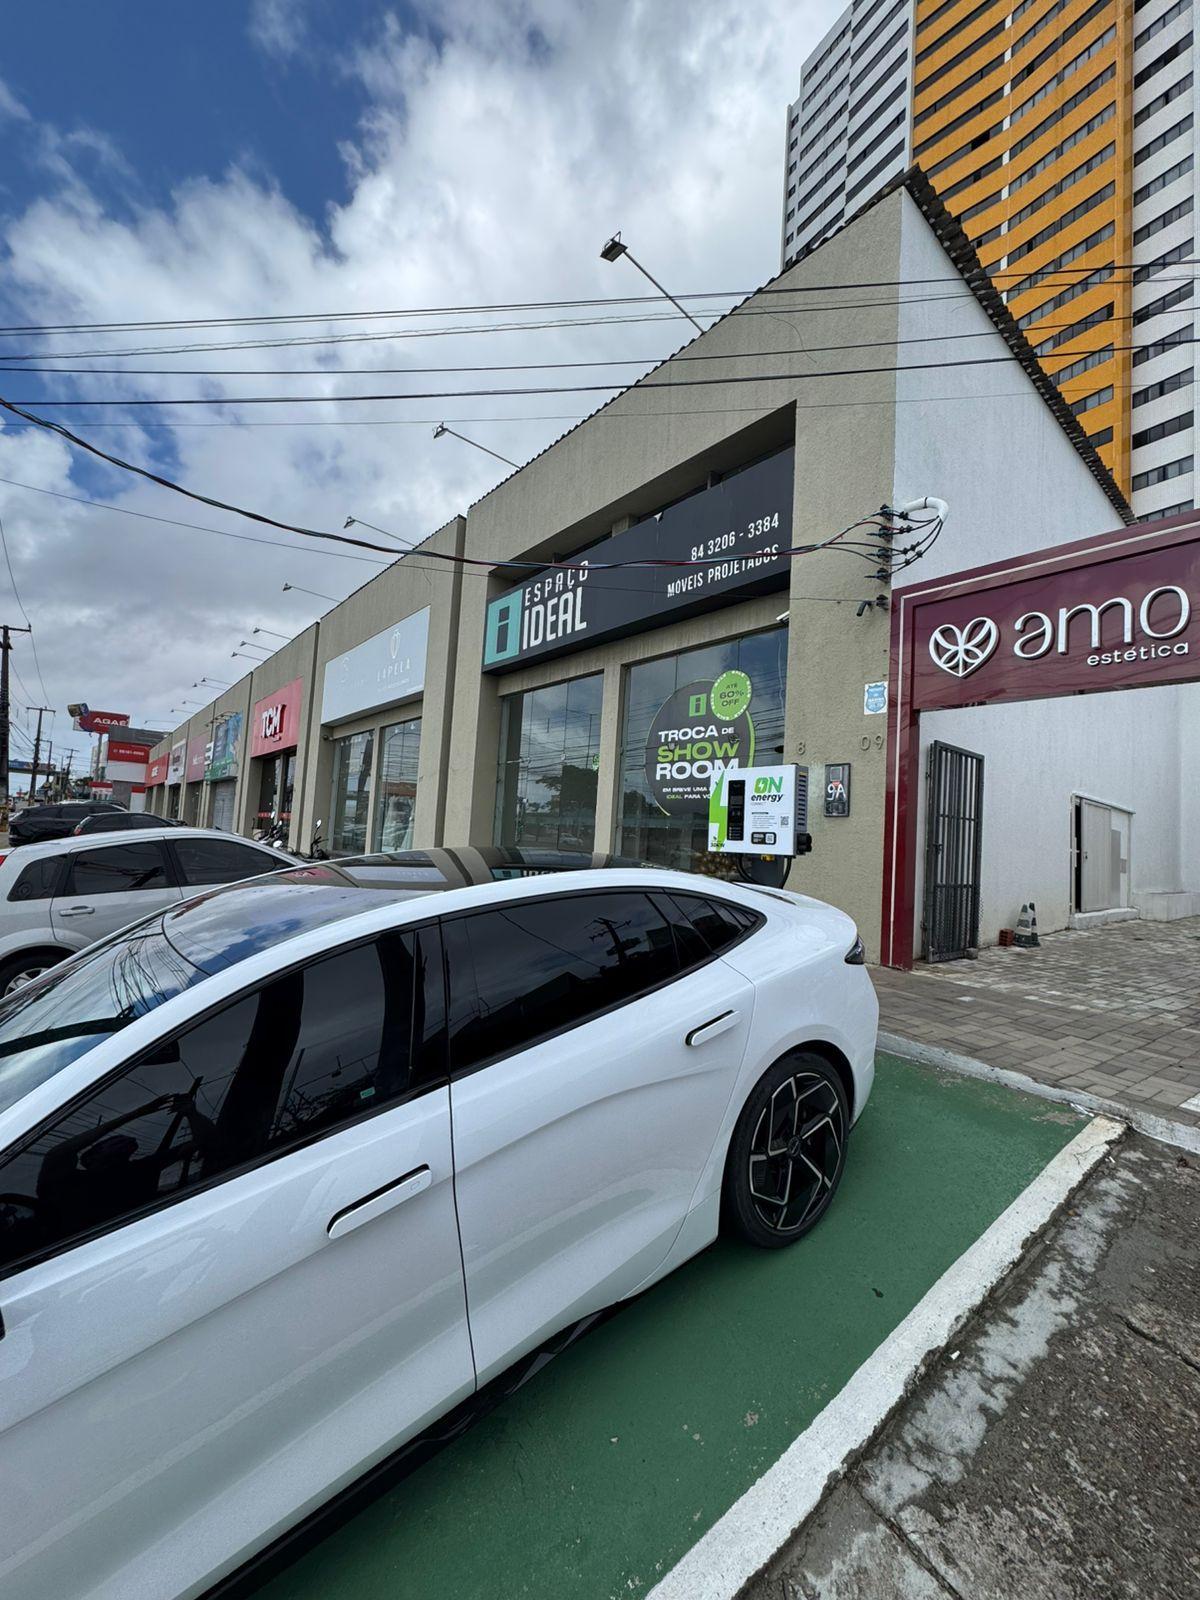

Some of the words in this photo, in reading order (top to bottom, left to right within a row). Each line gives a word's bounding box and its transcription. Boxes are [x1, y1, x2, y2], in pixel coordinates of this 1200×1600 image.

[691, 544, 704, 561] 84
[707, 531, 736, 555] 3206
[748, 512, 779, 539] 3384
[707, 544, 780, 583] PROJETADOS
[524, 560, 589, 607] ESPAÇO
[522, 587, 587, 650] IDEAL
[1013, 585, 1191, 660] amo
[1087, 641, 1190, 667] estética
[262, 704, 283, 738] TCM
[658, 725, 719, 742] TROCA
[657, 741, 740, 763] SHOW
[656, 758, 739, 780] ROOM
[751, 793, 784, 803] energy
[753, 775, 784, 794] ON
